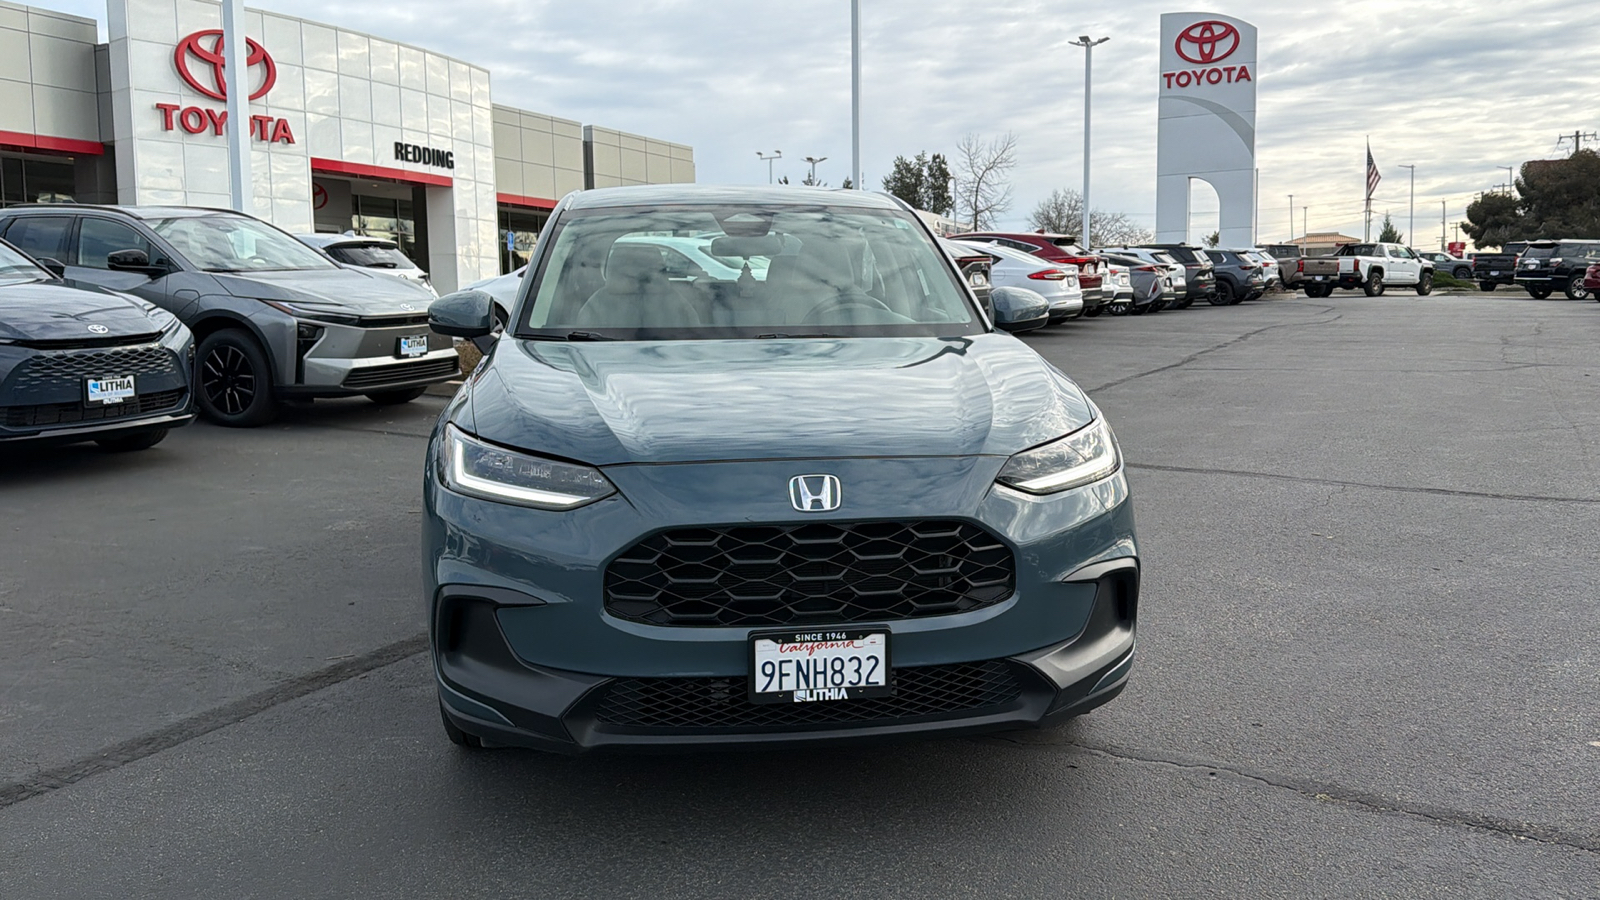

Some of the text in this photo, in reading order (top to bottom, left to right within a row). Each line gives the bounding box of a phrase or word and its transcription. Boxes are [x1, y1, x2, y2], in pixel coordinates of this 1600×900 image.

[1163, 66, 1251, 89] TOYOTA
[156, 103, 295, 144] TOYTA
[394, 142, 454, 169] REDDING
[100, 380, 132, 392] LITHIA
[795, 632, 847, 642] SINCE 1946
[779, 640, 864, 656] California
[761, 655, 880, 692] 9FNH832
[806, 687, 848, 702] LITHIA
